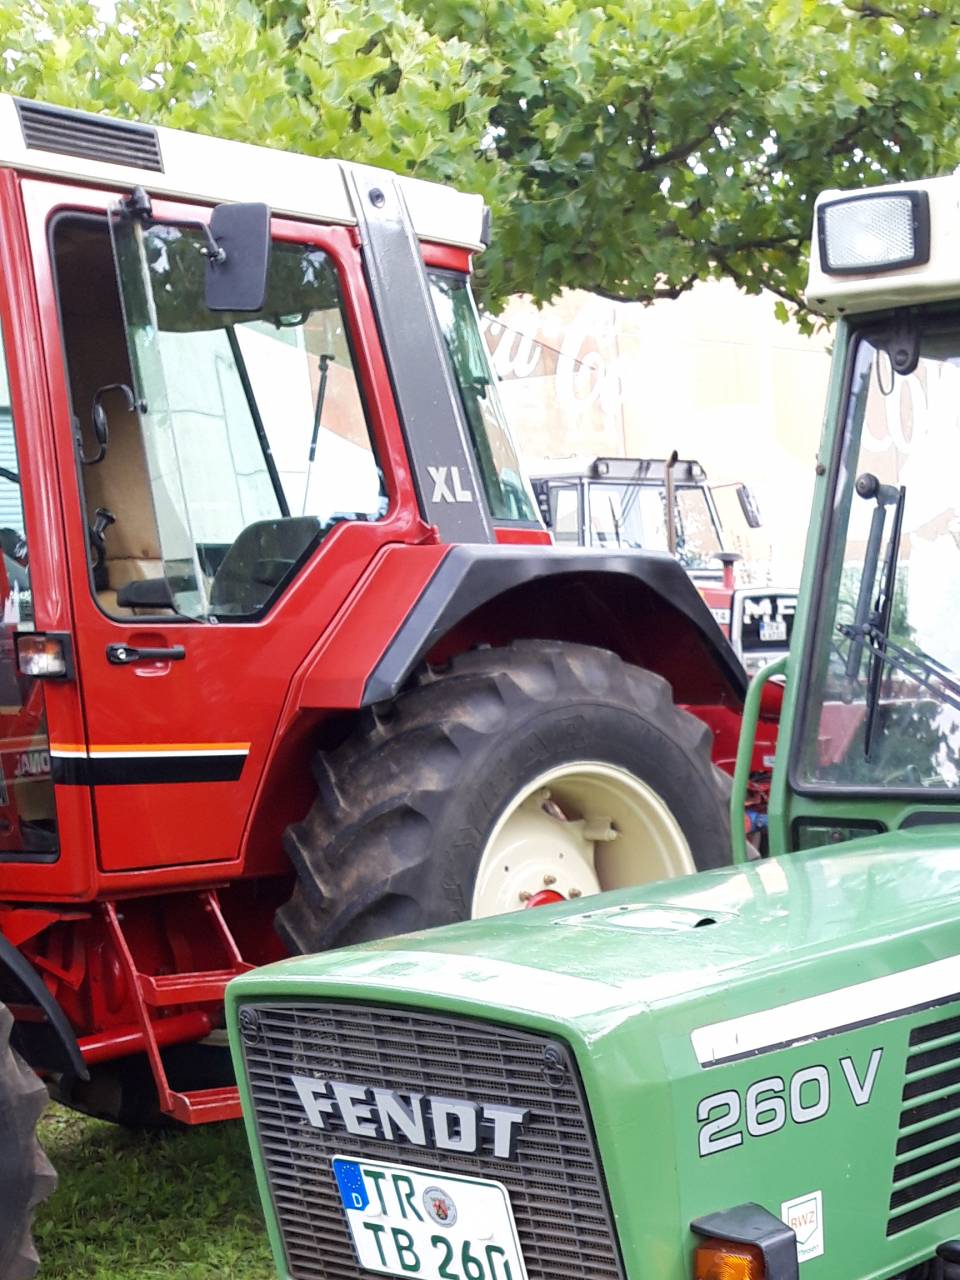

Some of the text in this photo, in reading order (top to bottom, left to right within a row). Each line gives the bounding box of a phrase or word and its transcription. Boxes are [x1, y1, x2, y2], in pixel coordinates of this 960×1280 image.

[427, 465, 473, 503] XL
[743, 597, 798, 624] MF
[291, 1075, 530, 1159] FENDT
[697, 1046, 885, 1158] 260 V
[351, 1192, 364, 1209] D
[363, 1168, 425, 1223] TR
[363, 1221, 422, 1273] TB
